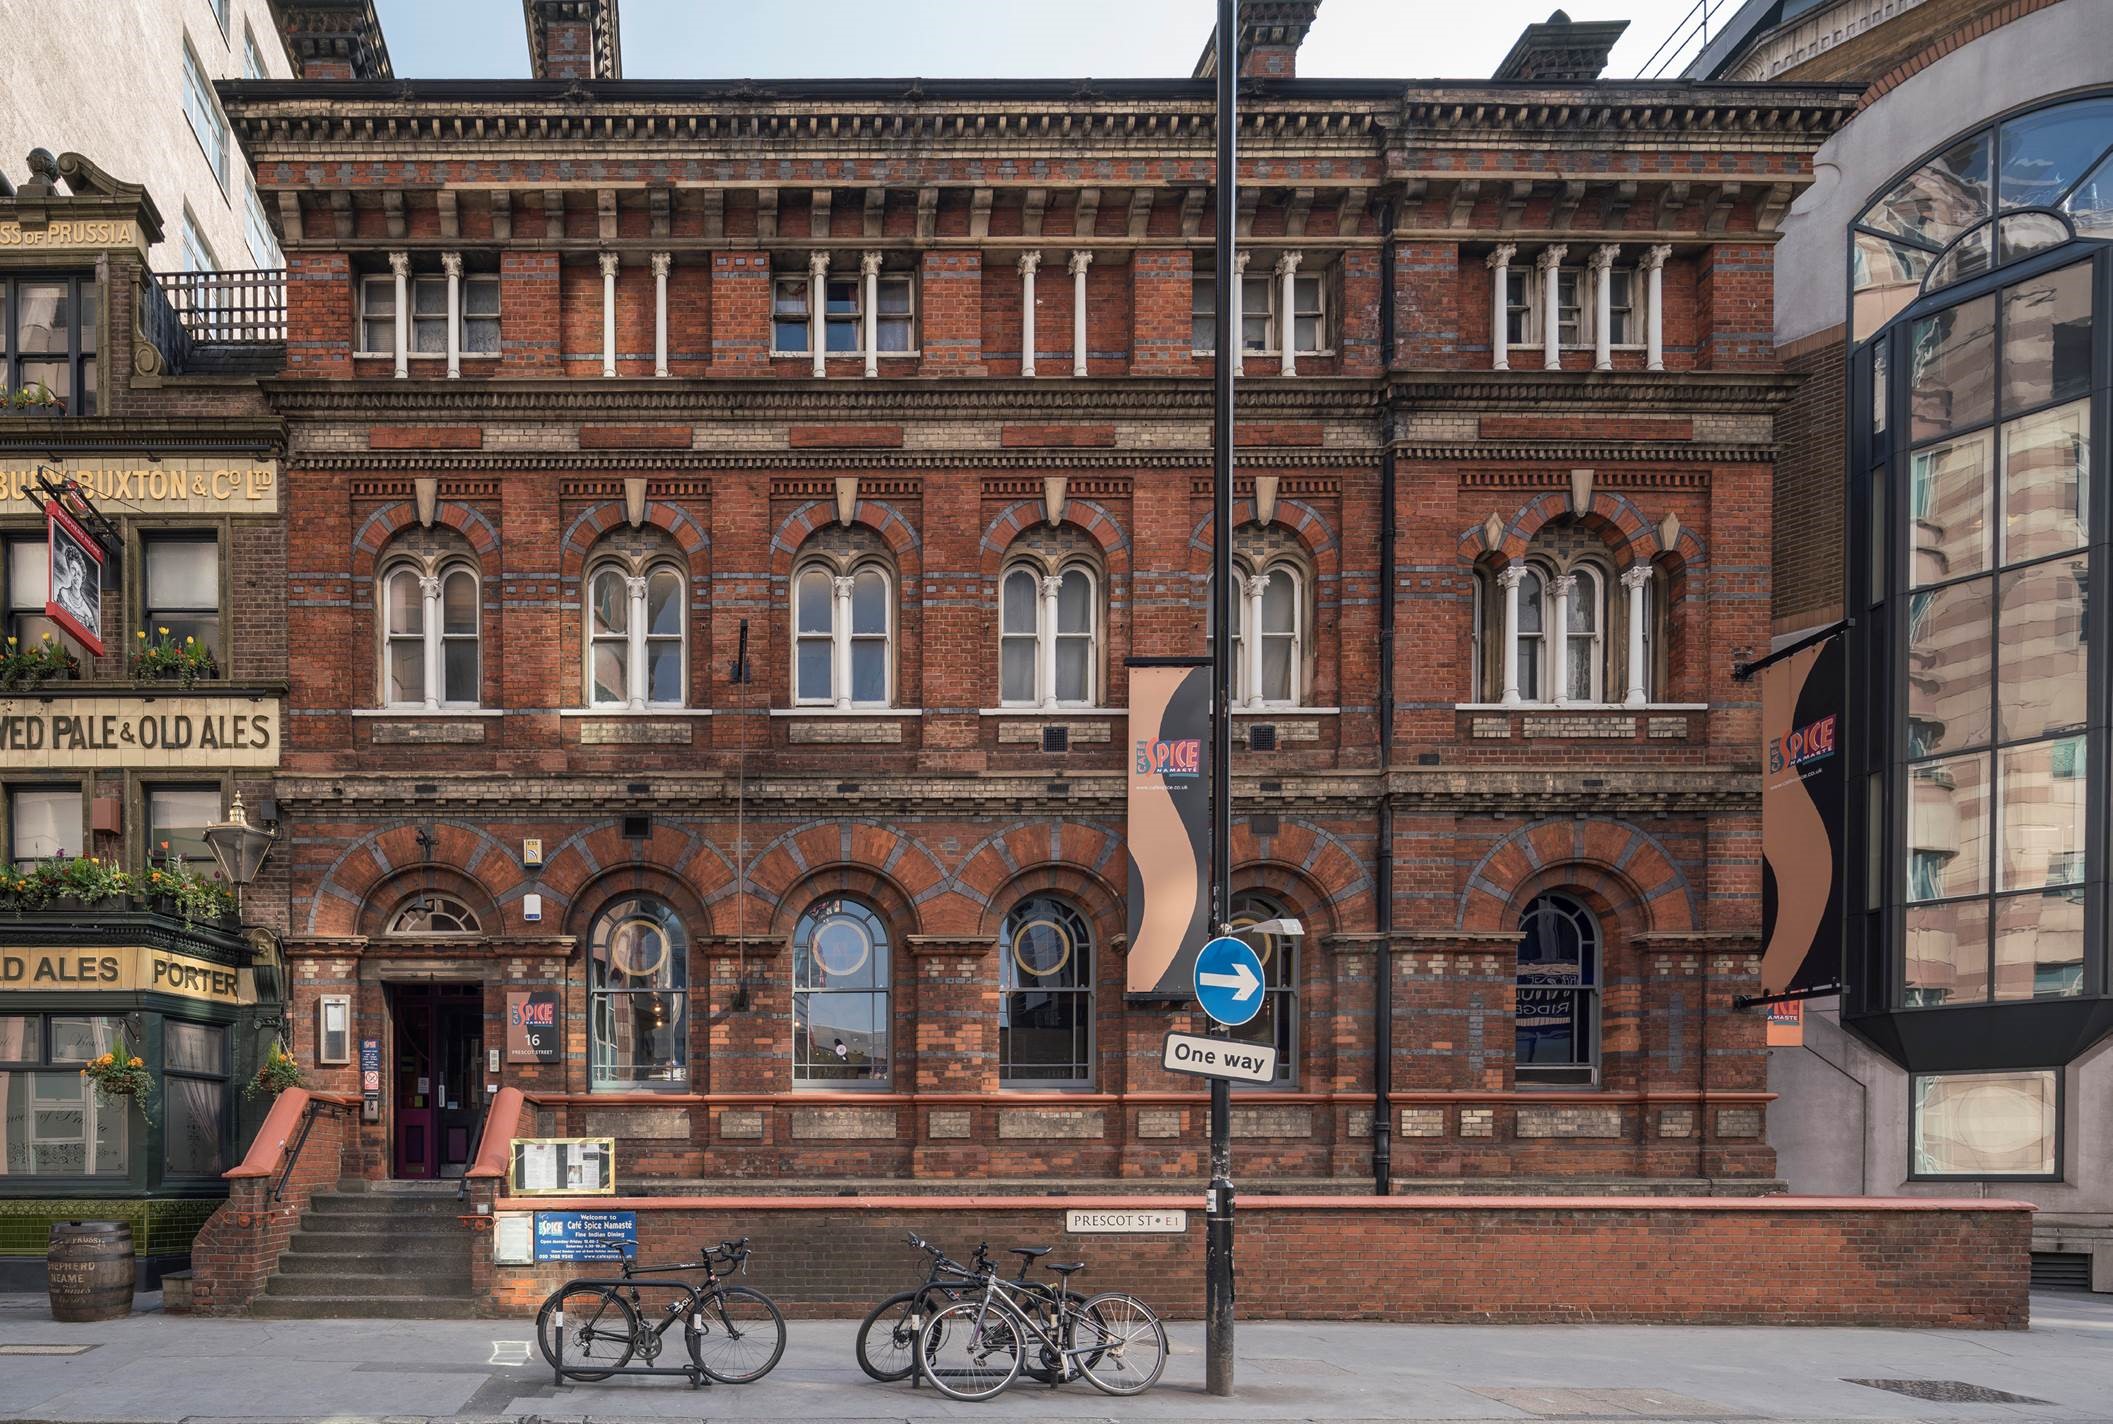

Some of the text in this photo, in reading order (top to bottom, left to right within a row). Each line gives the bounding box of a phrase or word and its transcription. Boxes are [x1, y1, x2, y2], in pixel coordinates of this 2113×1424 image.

[24, 232, 44, 245] OF
[48, 223, 133, 244] PRUSSIA
[77, 470, 187, 500] BUXTON
[192, 474, 208, 496] &
[52, 715, 118, 749] PALE
[120, 722, 136, 744] &
[139, 715, 192, 749] OLD
[199, 715, 270, 749] ALES
[1781, 717, 1834, 768] SPICE
[1144, 737, 1198, 778] SPICE
[33, 957, 119, 982] ALES
[153, 959, 238, 998] PORTER
[518, 1000, 553, 1027] SPICE
[525, 1034, 540, 1046] 16
[1174, 1043, 1265, 1074] One way
[567, 1220, 582, 1229] Café
[584, 1221, 602, 1231] Spice
[1074, 1215, 1133, 1226] PRESCOT
[1138, 1215, 1153, 1226] ST
